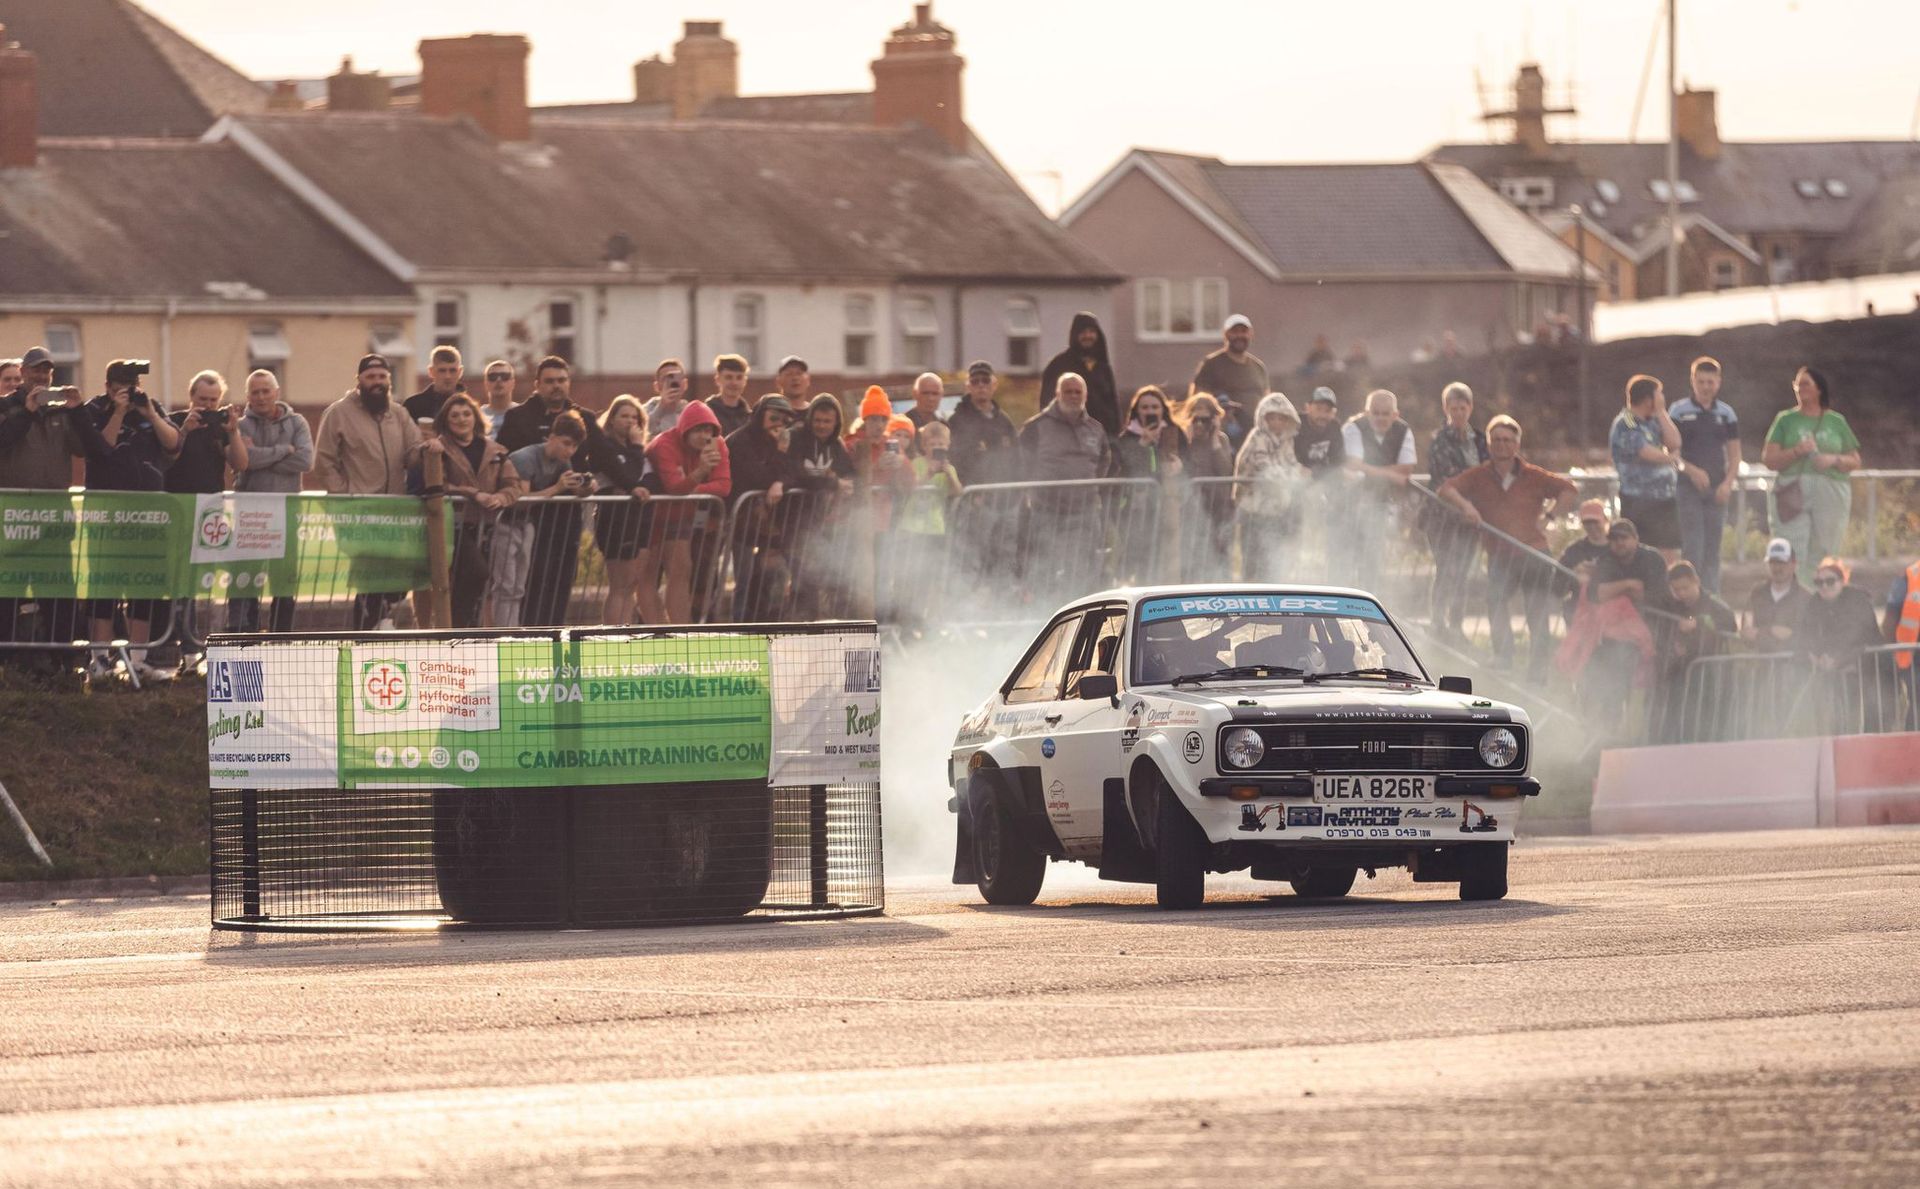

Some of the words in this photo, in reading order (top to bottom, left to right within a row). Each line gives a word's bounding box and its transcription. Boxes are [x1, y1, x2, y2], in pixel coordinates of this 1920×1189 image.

[4, 509, 61, 522] ENGAGE.
[63, 510, 110, 523] INSPIRE.
[114, 511, 172, 524] SUCCEED.
[3, 525, 41, 540] WITH
[296, 526, 336, 541] GYDA
[1181, 597, 1271, 613] PROBITE
[1279, 599, 1339, 611] BRC
[419, 661, 475, 676] Cambrian
[419, 673, 466, 689] Training
[419, 690, 491, 705] Hyfforddiant
[516, 683, 584, 704] GYDA
[589, 677, 762, 702] PRENTISIAETHAU.
[419, 703, 476, 718] Cambrian
[844, 744, 859, 754] WEST
[1362, 741, 1387, 753] FORD
[226, 753, 256, 762] RECYCLING
[257, 753, 291, 762] EXPERTS
[517, 742, 765, 770] CAMBRIANTRAINING.COM
[1323, 778, 1363, 799] UEA
[1370, 778, 1425, 798] 826R
[1340, 807, 1402, 817] ANTHONY
[1326, 828, 1364, 838] 07970
[1370, 828, 1390, 837] 013
[1395, 828, 1417, 837] 043
